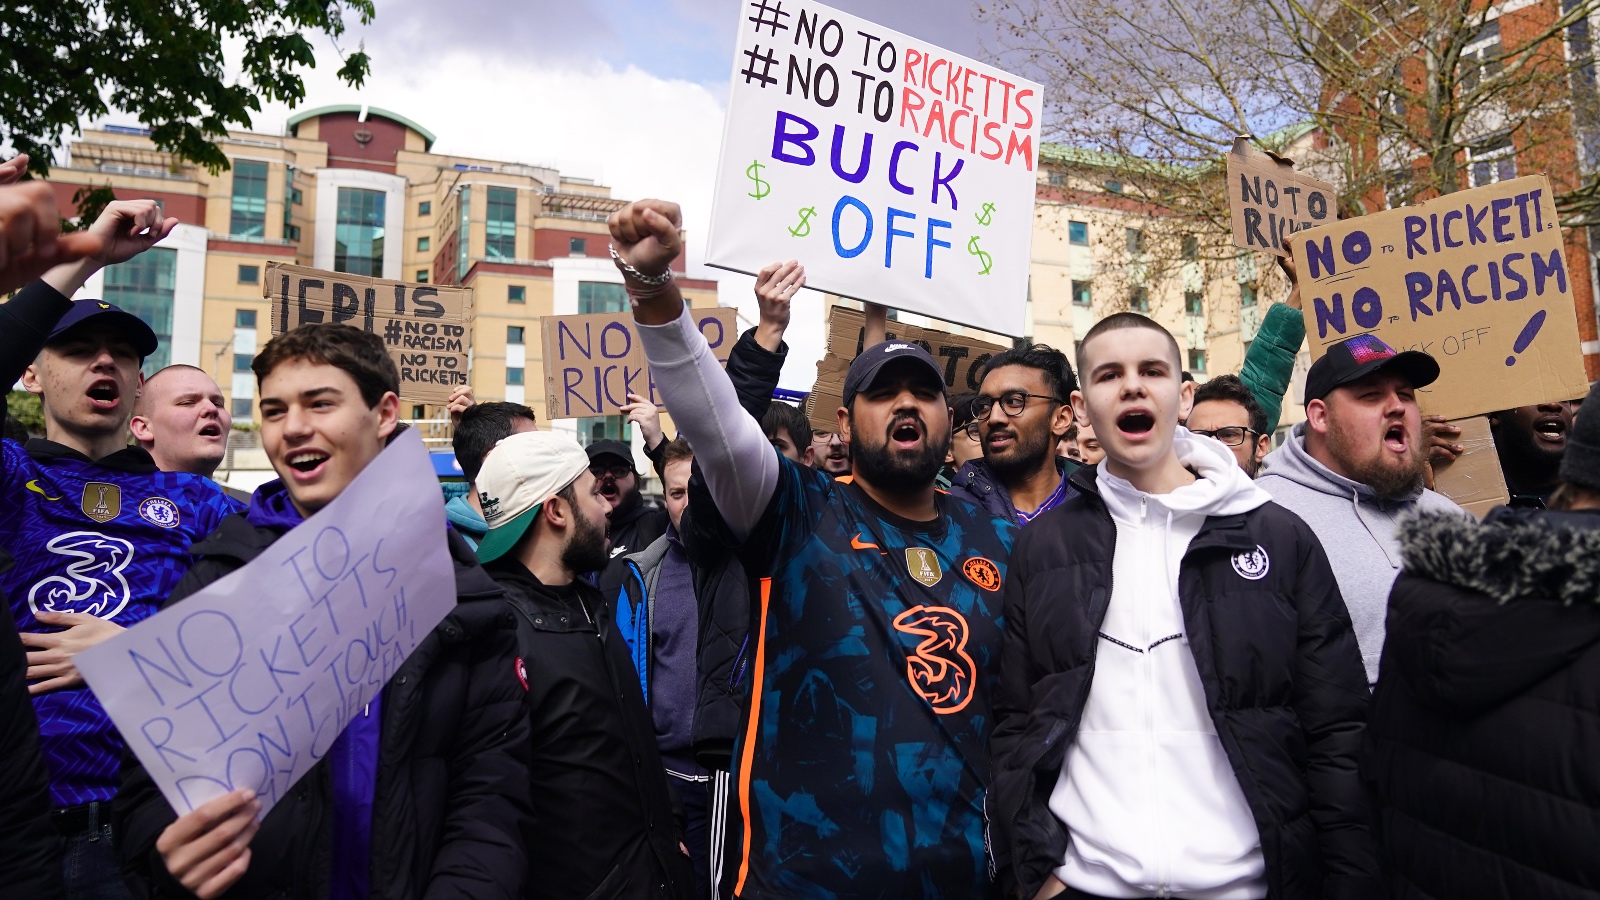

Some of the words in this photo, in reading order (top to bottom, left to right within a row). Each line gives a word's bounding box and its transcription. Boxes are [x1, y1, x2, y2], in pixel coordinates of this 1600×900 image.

[857, 30, 897, 73] TO
[903, 48, 1034, 130] RICKETTS
[851, 70, 894, 123] TO
[899, 86, 1033, 171] RACISM
[771, 110, 965, 211] BUCK
[1240, 172, 1279, 209] NO
[1283, 186, 1328, 220] TO
[831, 195, 952, 279] OFF
[1305, 230, 1372, 279] NO
[1380, 244, 1395, 254] TO
[394, 284, 446, 319] IS
[1312, 286, 1383, 338] NO
[1386, 315, 1400, 324] TO
[1404, 247, 1567, 322] RACISM
[403, 335, 462, 352] RACISM
[441, 323, 465, 337] TO
[558, 320, 632, 360] NO
[1442, 326, 1492, 356] OFF
[1504, 309, 1548, 367] !
[401, 354, 427, 366] NO
[433, 356, 458, 369] TO
[402, 367, 467, 385] RICKETTS
[127, 608, 244, 707] NO
[281, 525, 350, 603] TO
[140, 538, 397, 774] RICKETTS
[323, 586, 407, 704] TOUCH
